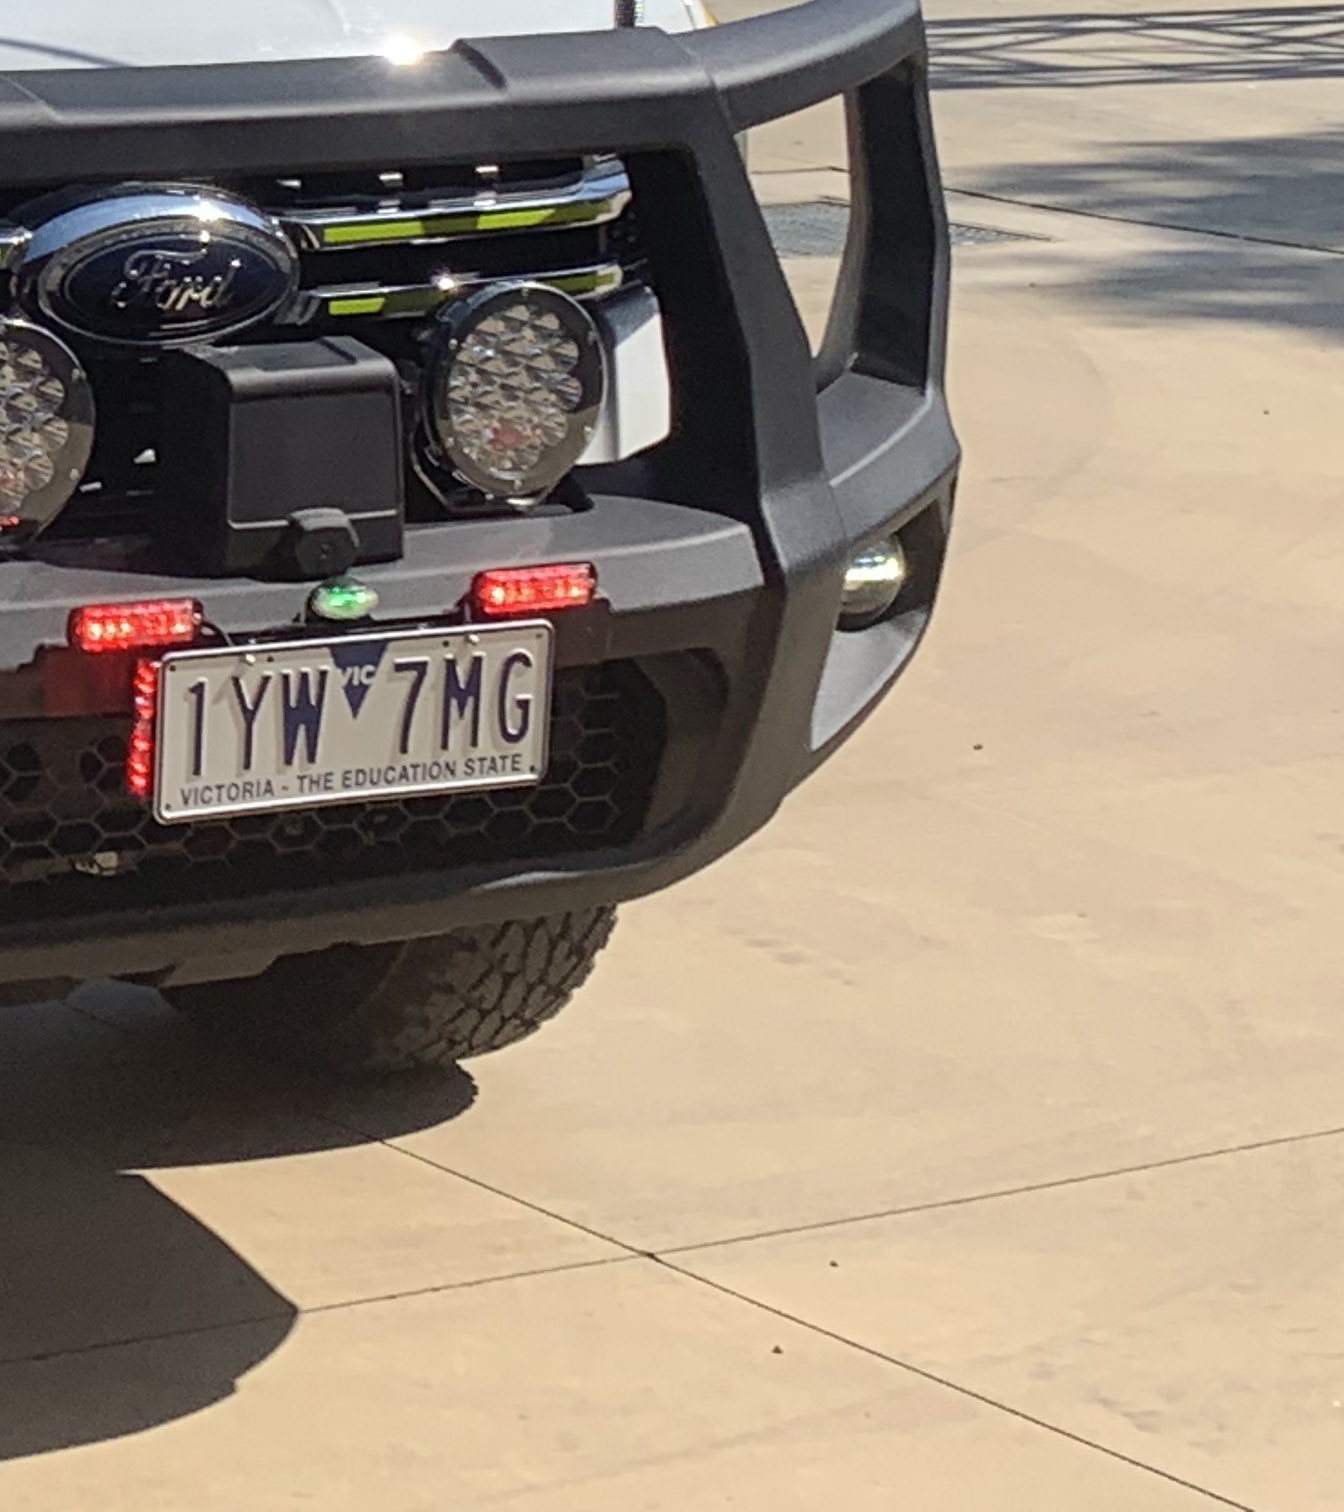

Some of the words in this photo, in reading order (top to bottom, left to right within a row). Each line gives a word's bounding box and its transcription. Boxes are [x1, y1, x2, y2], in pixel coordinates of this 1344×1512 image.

[112, 249, 241, 311] Ford
[339, 664, 377, 687] VIC
[188, 667, 330, 778] 1YW
[392, 650, 534, 756] 7MG
[180, 780, 274, 807] VICTORIA
[296, 771, 335, 791] THE
[342, 760, 456, 787] EDUCATION
[462, 753, 523, 775] STATE
